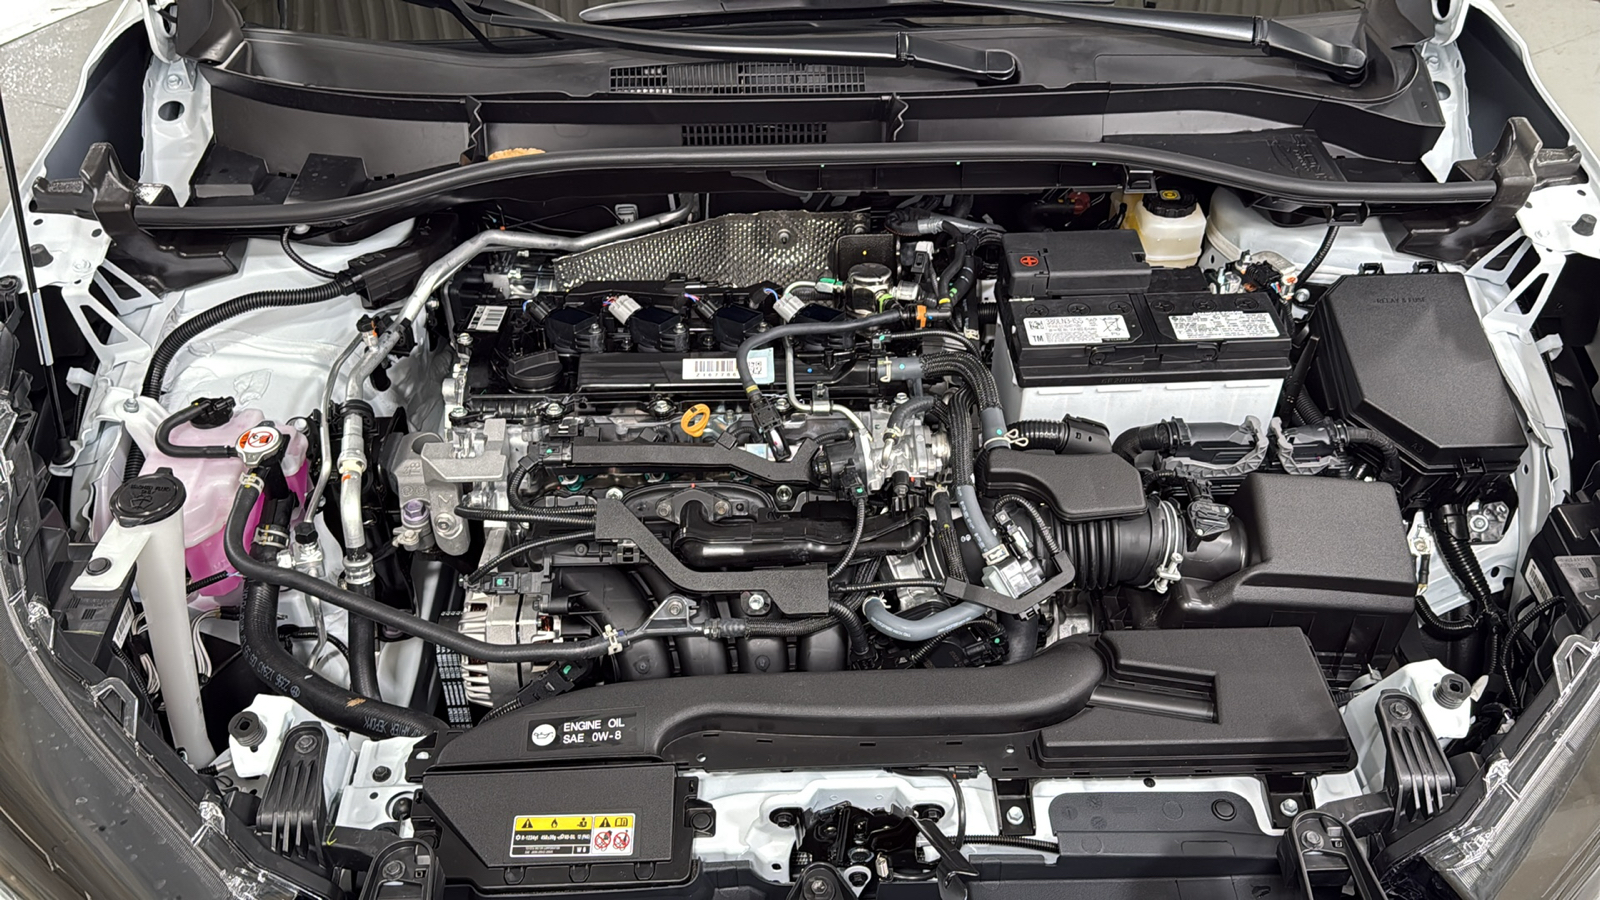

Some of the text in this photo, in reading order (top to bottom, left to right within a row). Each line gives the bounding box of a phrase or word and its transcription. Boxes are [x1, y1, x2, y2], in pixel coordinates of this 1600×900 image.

[1032, 335, 1044, 343] TM
[563, 718, 625, 732] ENGINE OIL
[562, 730, 622, 745] SAE 0W-8
